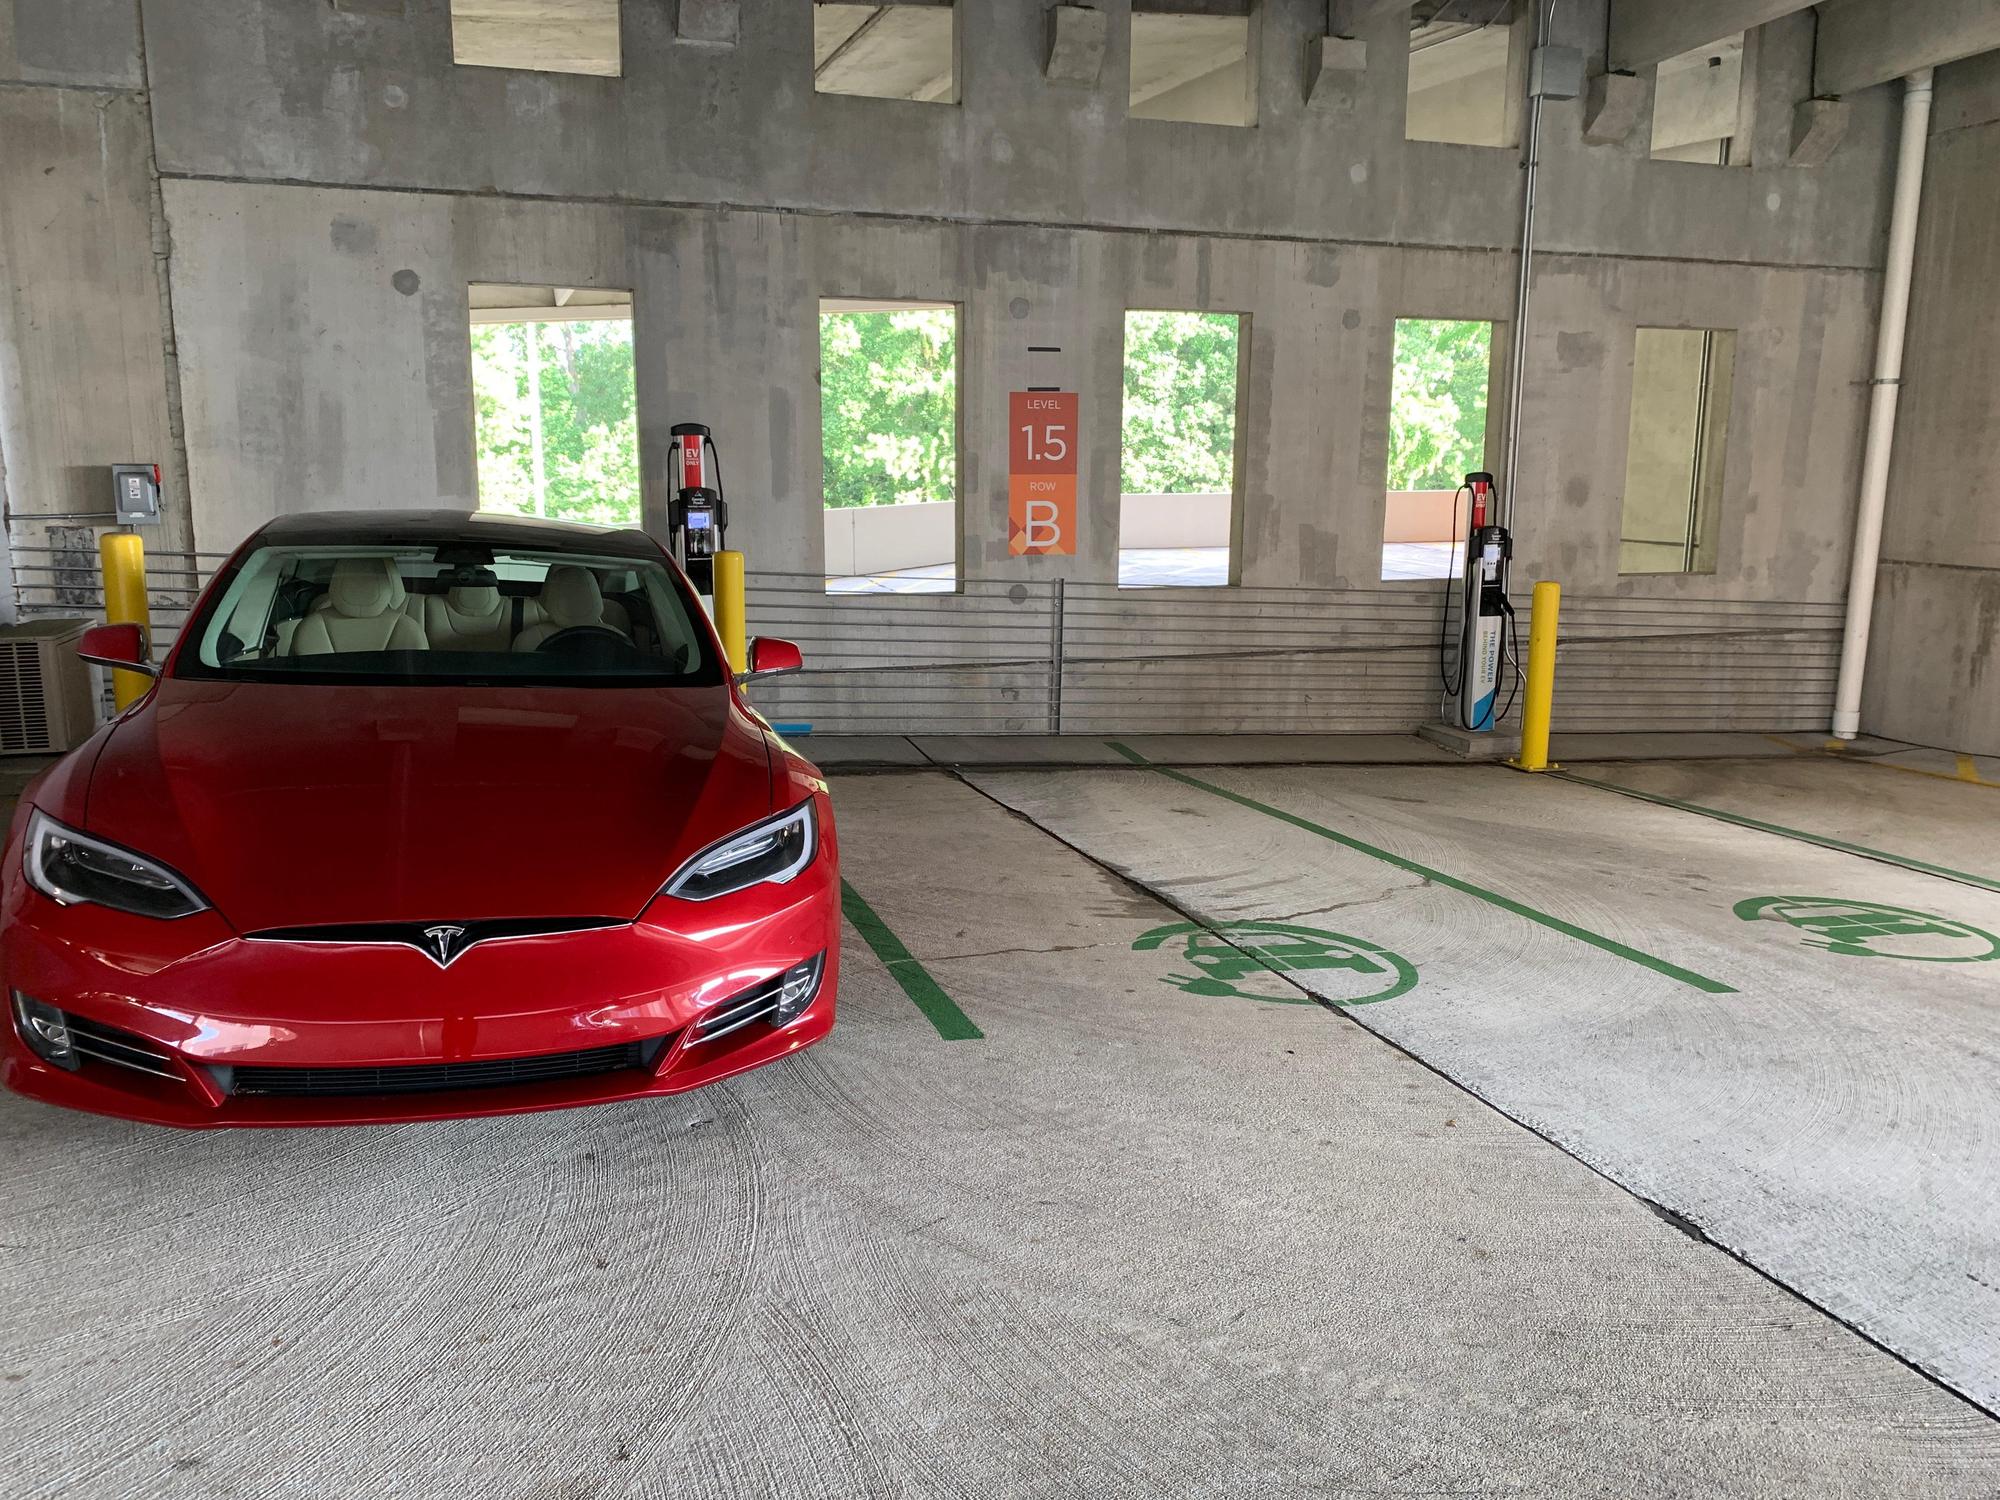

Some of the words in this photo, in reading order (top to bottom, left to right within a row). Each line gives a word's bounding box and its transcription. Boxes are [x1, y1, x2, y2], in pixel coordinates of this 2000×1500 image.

[1027, 399, 1061, 410] LEVEL
[686, 448, 699, 458] EV
[1021, 424, 1067, 461] 1.5
[1030, 481, 1056, 491] ROW
[1025, 500, 1061, 547] B
[1487, 650, 1495, 683] POWER
